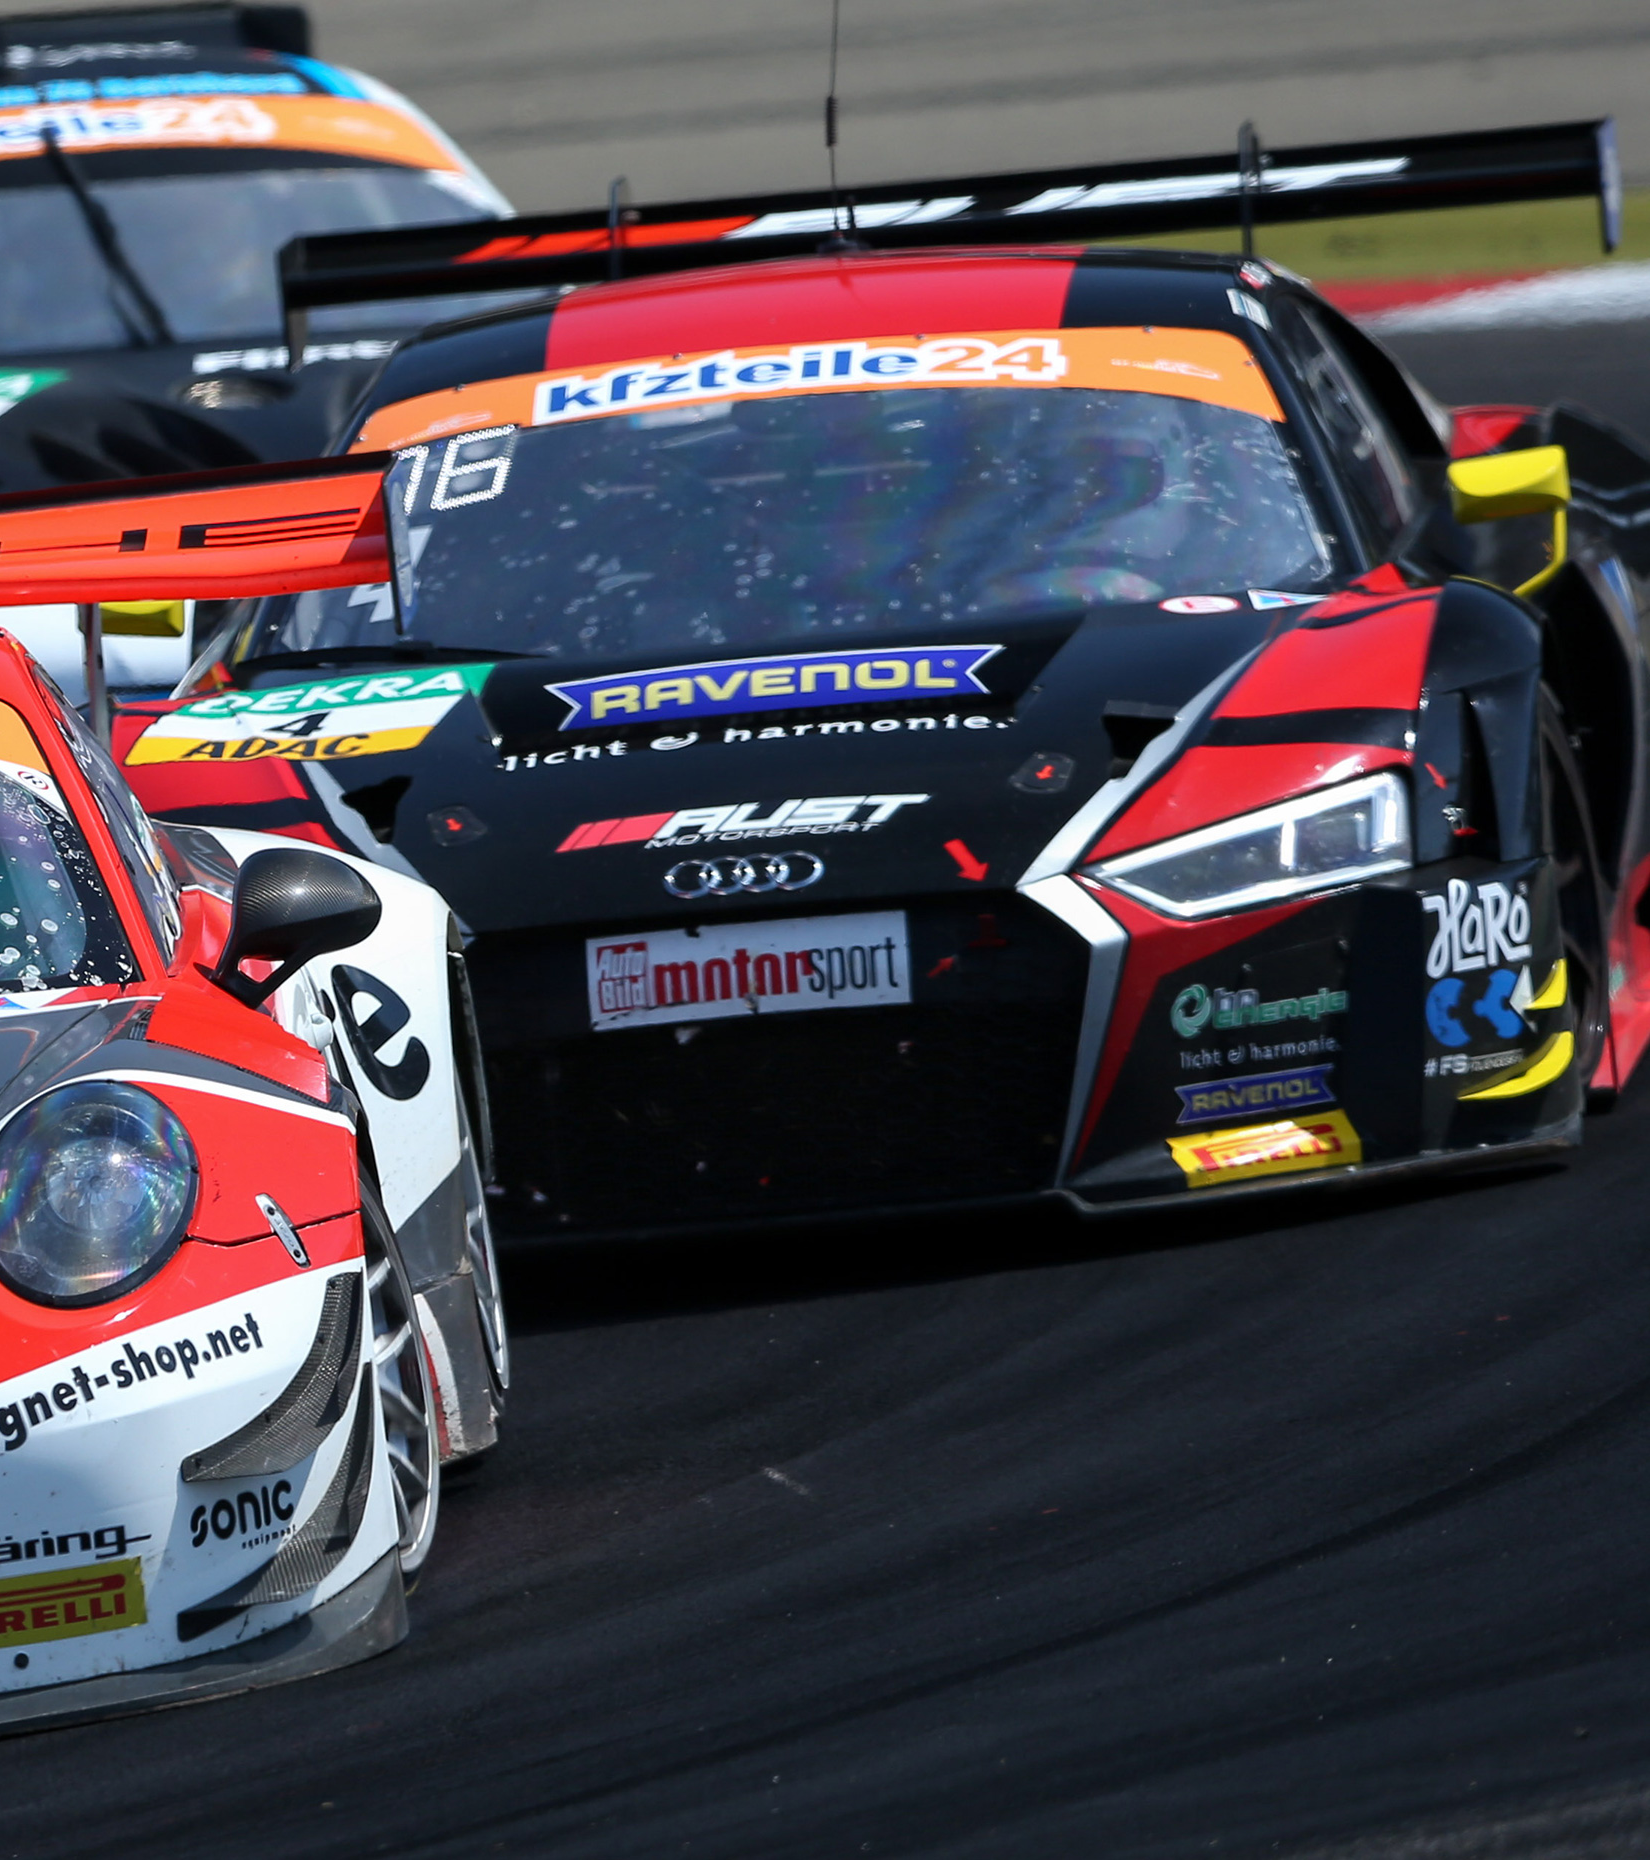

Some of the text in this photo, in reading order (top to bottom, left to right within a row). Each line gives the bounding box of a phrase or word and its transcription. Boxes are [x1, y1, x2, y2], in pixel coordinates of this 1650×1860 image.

[548, 339, 1055, 412] kfzteile24
[188, 668, 467, 716] DEKRA
[590, 657, 958, 719] RAVENOL
[264, 711, 331, 738] 4
[182, 733, 372, 760] ADAC
[503, 740, 628, 772] licht
[653, 793, 931, 840] AUST
[644, 820, 880, 850] MOTORSPORT
[653, 937, 899, 1006] motorsport
[1180, 1049, 1223, 1069] licht
[1191, 1078, 1320, 1112] RAVENOL
[1192, 1123, 1343, 1171] PIRELLI
[241, 1523, 297, 1549] equipment
